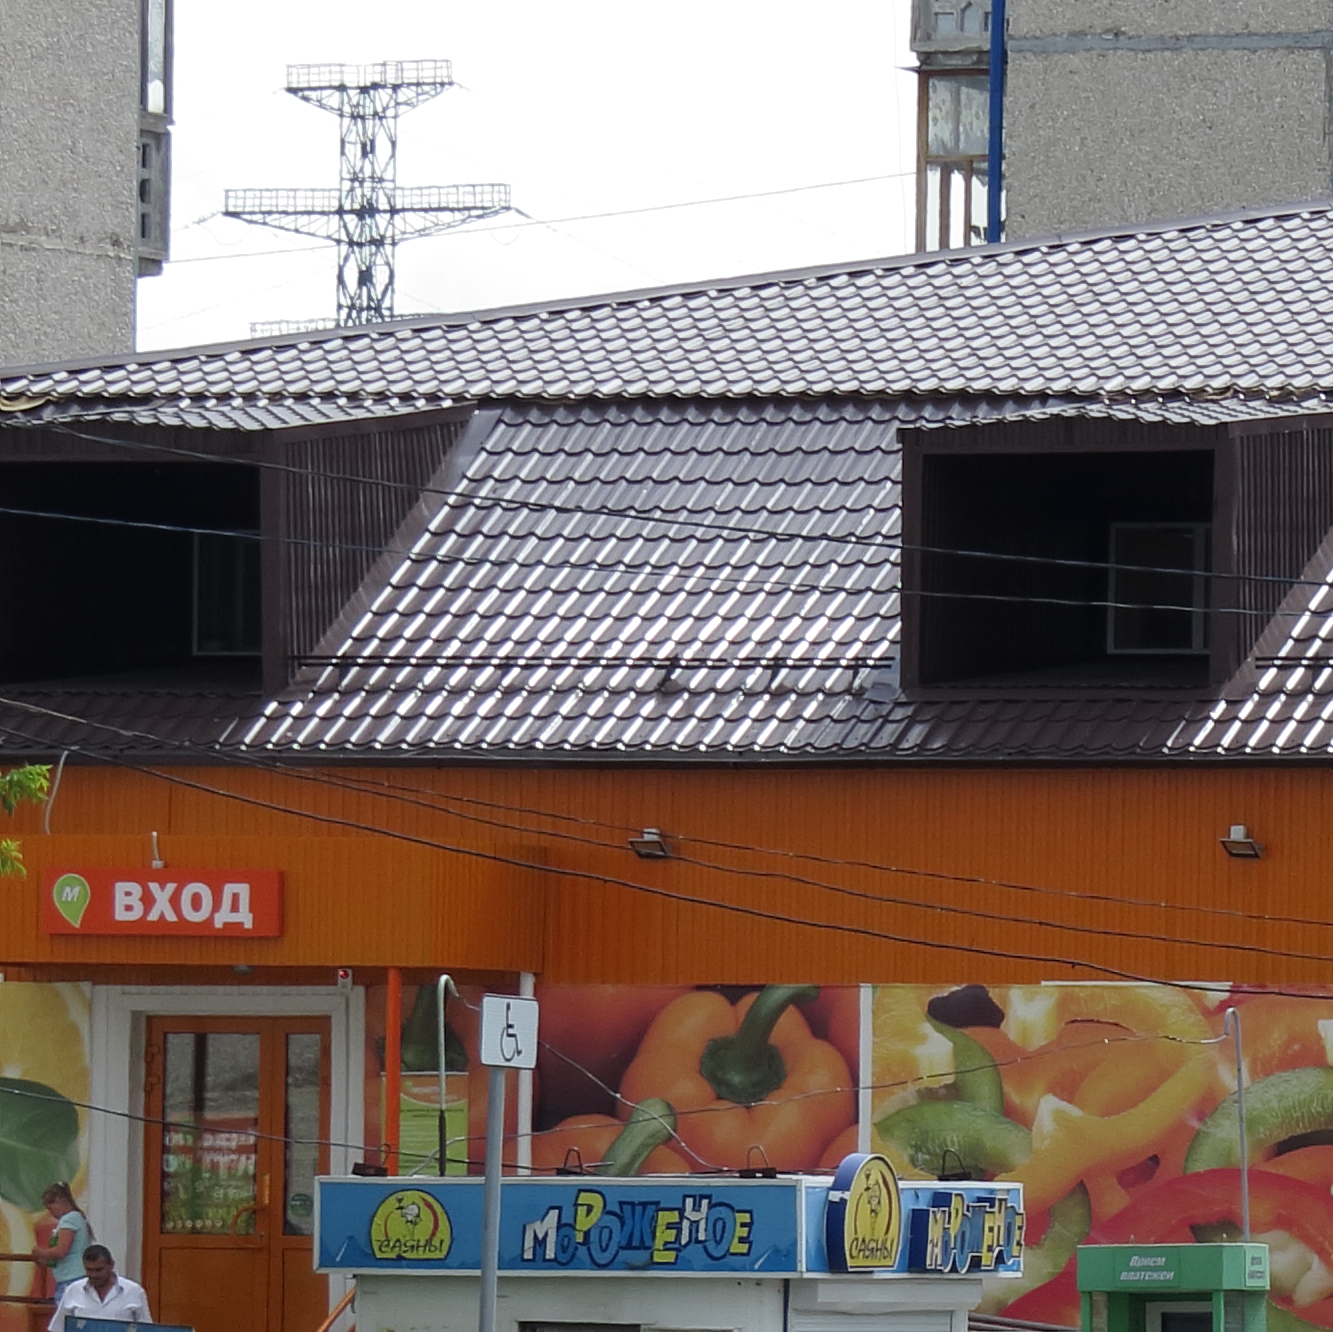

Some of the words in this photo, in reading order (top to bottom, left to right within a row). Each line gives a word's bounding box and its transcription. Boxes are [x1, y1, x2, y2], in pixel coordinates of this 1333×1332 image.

[114, 881, 254, 929] ВХОД
[521, 1188, 754, 1267] МОРОЖЕНОЕ
[850, 1237, 895, 1260] САЯНЫ
